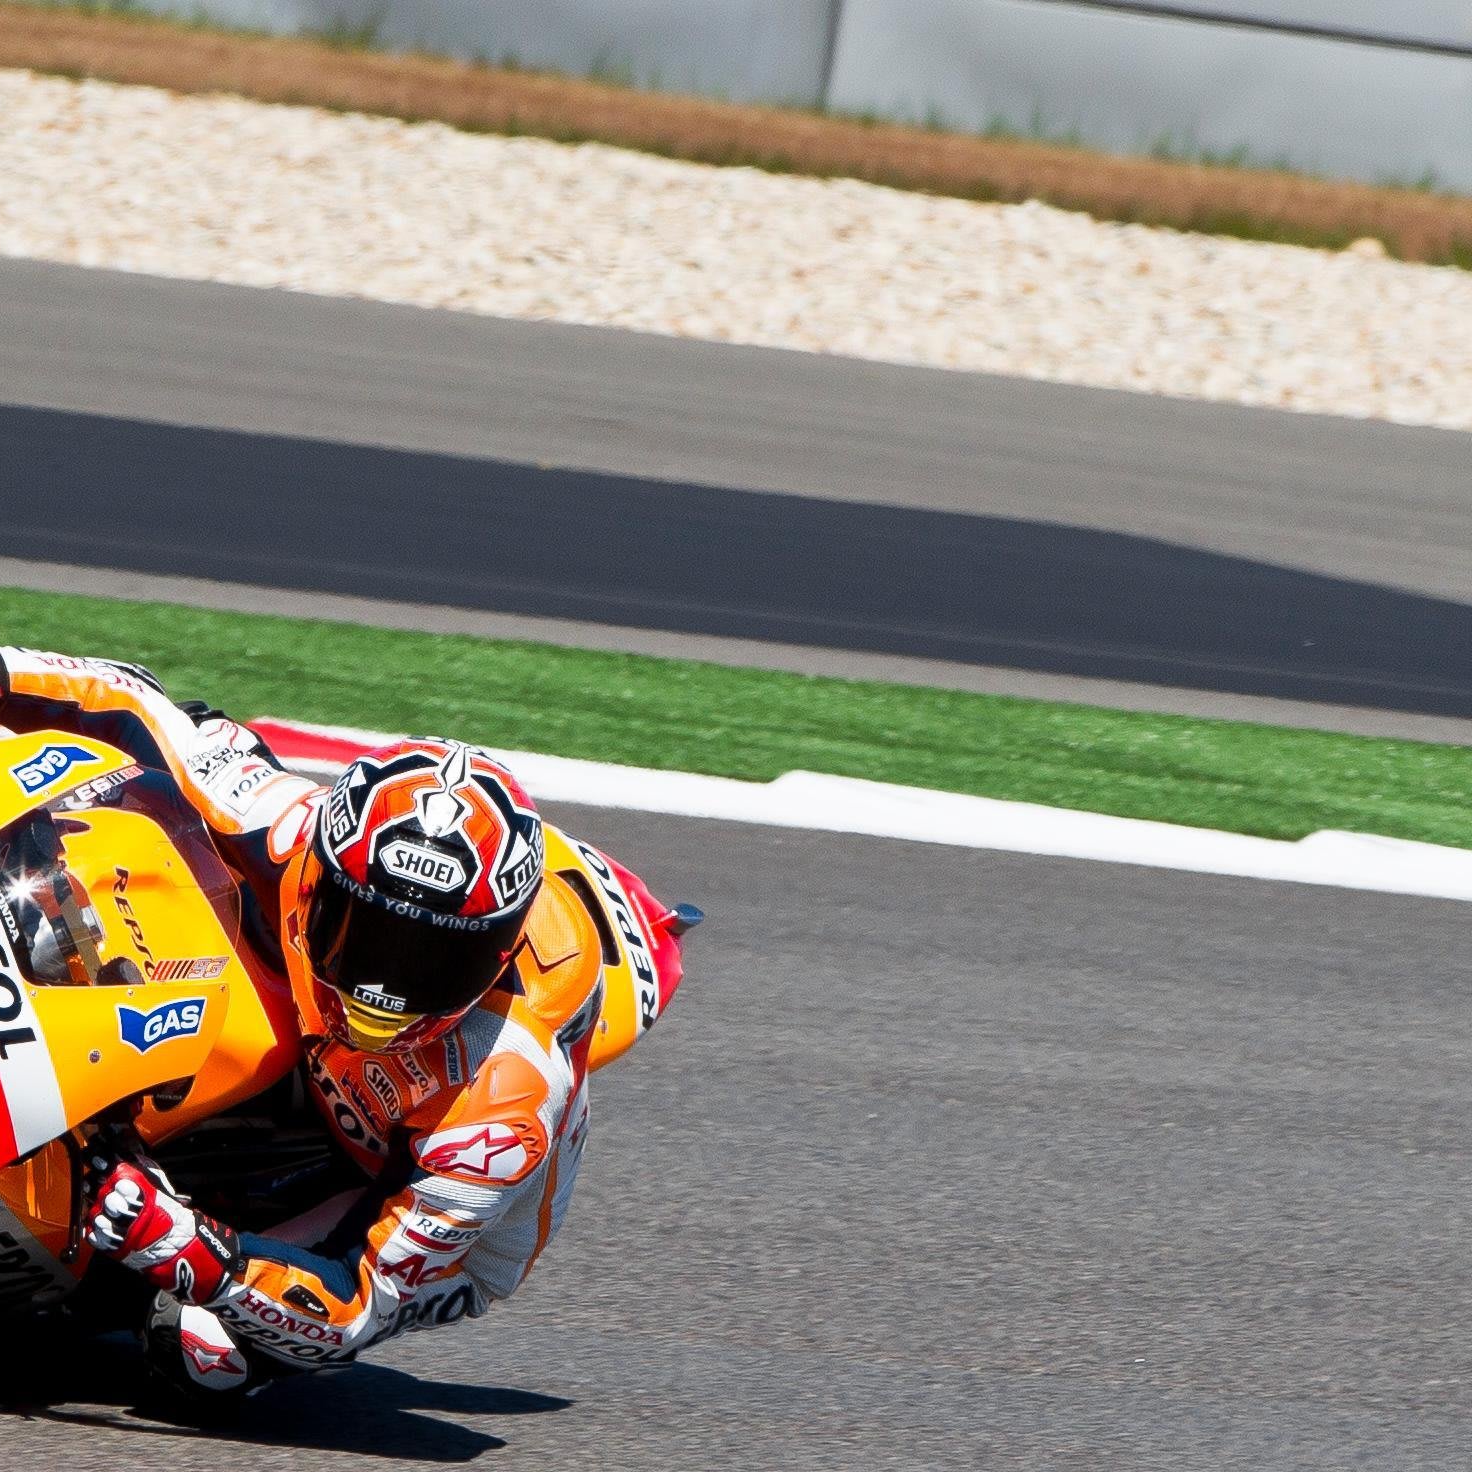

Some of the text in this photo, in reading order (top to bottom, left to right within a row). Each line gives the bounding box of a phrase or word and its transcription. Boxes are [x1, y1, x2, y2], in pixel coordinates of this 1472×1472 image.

[17, 749, 68, 787] GAS
[392, 849, 455, 884] SHOEI
[333, 872, 490, 932] GIVES YOU WINGS
[352, 989, 405, 1012] LOTUS
[143, 1004, 201, 1042] GAS
[367, 1068, 401, 1118] SHOEI
[238, 1292, 343, 1346] HONDA
